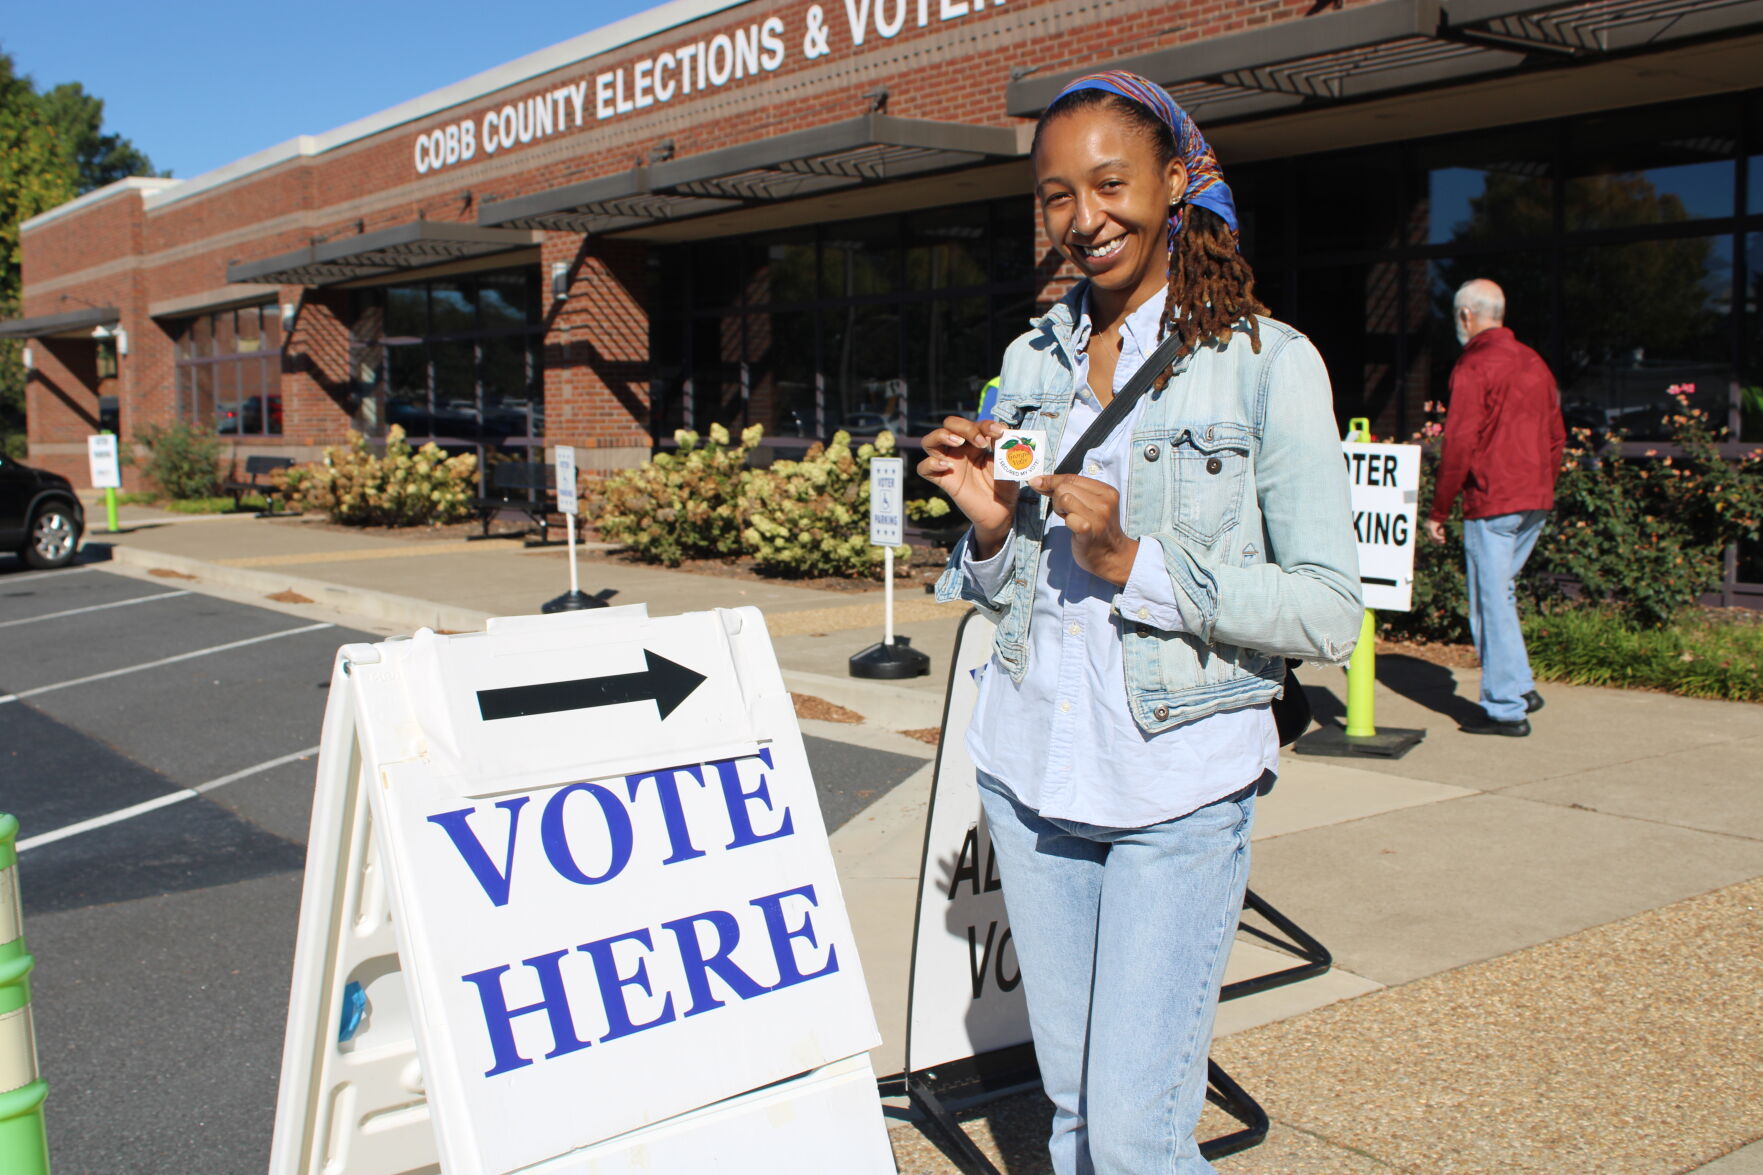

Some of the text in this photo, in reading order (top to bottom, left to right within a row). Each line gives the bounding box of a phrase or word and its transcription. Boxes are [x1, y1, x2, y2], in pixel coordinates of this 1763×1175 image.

[414, 119, 476, 174] COBB
[482, 80, 587, 154] COUNTY
[596, 16, 785, 120] ELECTIONS
[803, 4, 831, 59] &
[426, 747, 795, 908] VOTE
[461, 884, 840, 1078] HERE
